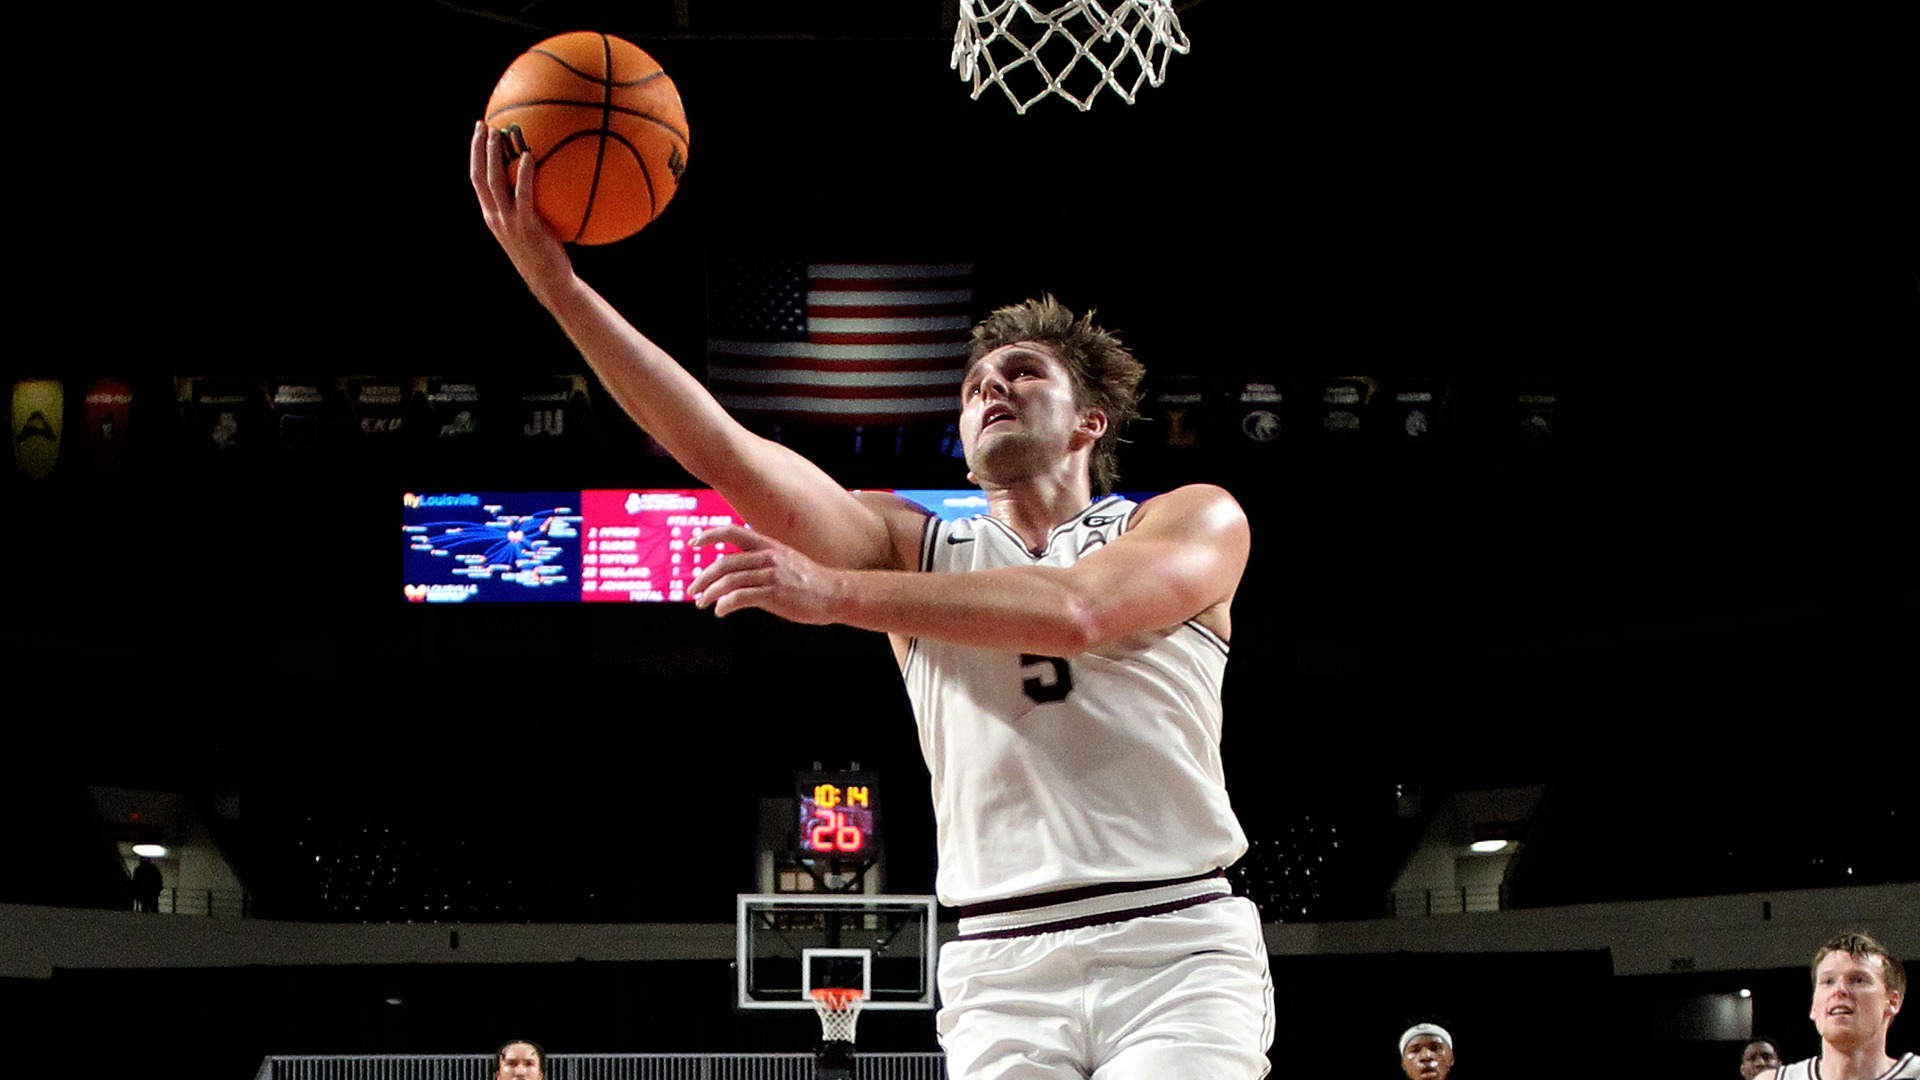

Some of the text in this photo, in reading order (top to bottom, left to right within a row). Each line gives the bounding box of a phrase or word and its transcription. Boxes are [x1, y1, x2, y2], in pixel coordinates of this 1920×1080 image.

[523, 409, 564, 436] JU
[1020, 653, 1073, 704] 5
[810, 809, 865, 852] 26
